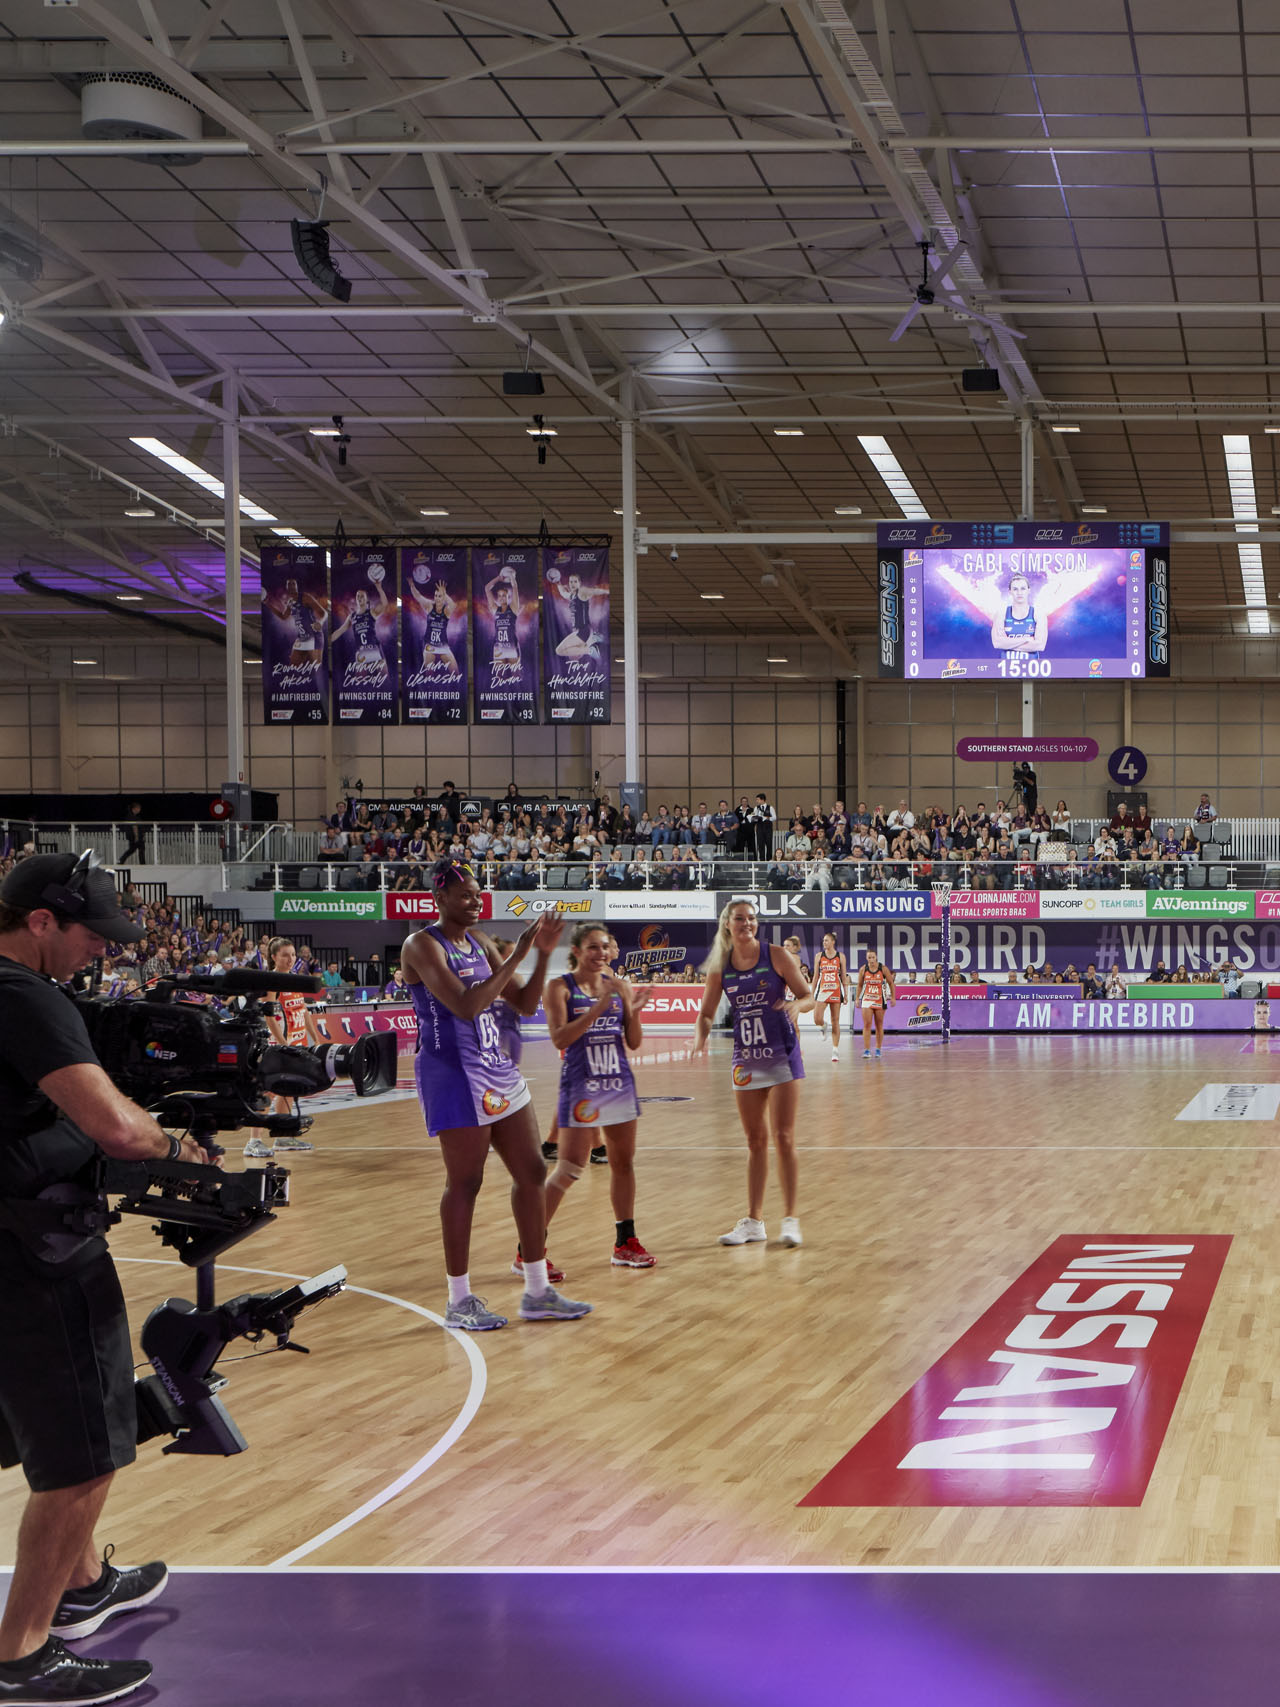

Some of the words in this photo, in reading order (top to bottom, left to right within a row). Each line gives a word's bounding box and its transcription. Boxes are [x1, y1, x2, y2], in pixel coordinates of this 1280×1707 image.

[963, 552, 1002, 573] GABI
[1010, 552, 1088, 573] SIMPSON
[420, 660, 450, 674] Laura
[566, 660, 589, 674] Tara
[909, 662, 919, 676] 0
[997, 659, 1051, 677] 15:00
[1131, 662, 1140, 676] 0
[343, 672, 388, 688] Cassidy
[406, 670, 463, 687] Clemesha
[1060, 745, 1088, 753] 104-107
[1117, 752, 1138, 780] 4
[280, 899, 376, 916] AVJennings
[732, 895, 807, 916] BLK
[831, 896, 925, 913] SAMSUNG
[952, 908, 980, 917] NETBALL
[982, 908, 1007, 916] SPORTS
[1009, 908, 1027, 916] BRAS
[1042, 900, 1083, 909] SUNCORP
[1101, 900, 1120, 908] TEAM
[1122, 900, 1144, 908] GIRLS
[1152, 897, 1249, 915] AVJennings
[1268, 908, 1275, 916] #1
[627, 947, 686, 970] FIREBIRDS
[641, 998, 702, 1012] SSAN
[989, 1003, 995, 1027] I
[1016, 1003, 1050, 1027] AM
[1073, 1003, 1194, 1027] FIREBIRD
[479, 1012, 500, 1049] GS
[741, 1017, 767, 1046] GA
[155, 1050, 177, 1059] NEP
[585, 1043, 621, 1076] WA
[753, 1047, 773, 1059] UQ
[602, 1078, 624, 1092] UQ
[897, 1244, 1195, 1469] NISSAN
[152, 1356, 185, 1406] STEADICAM
